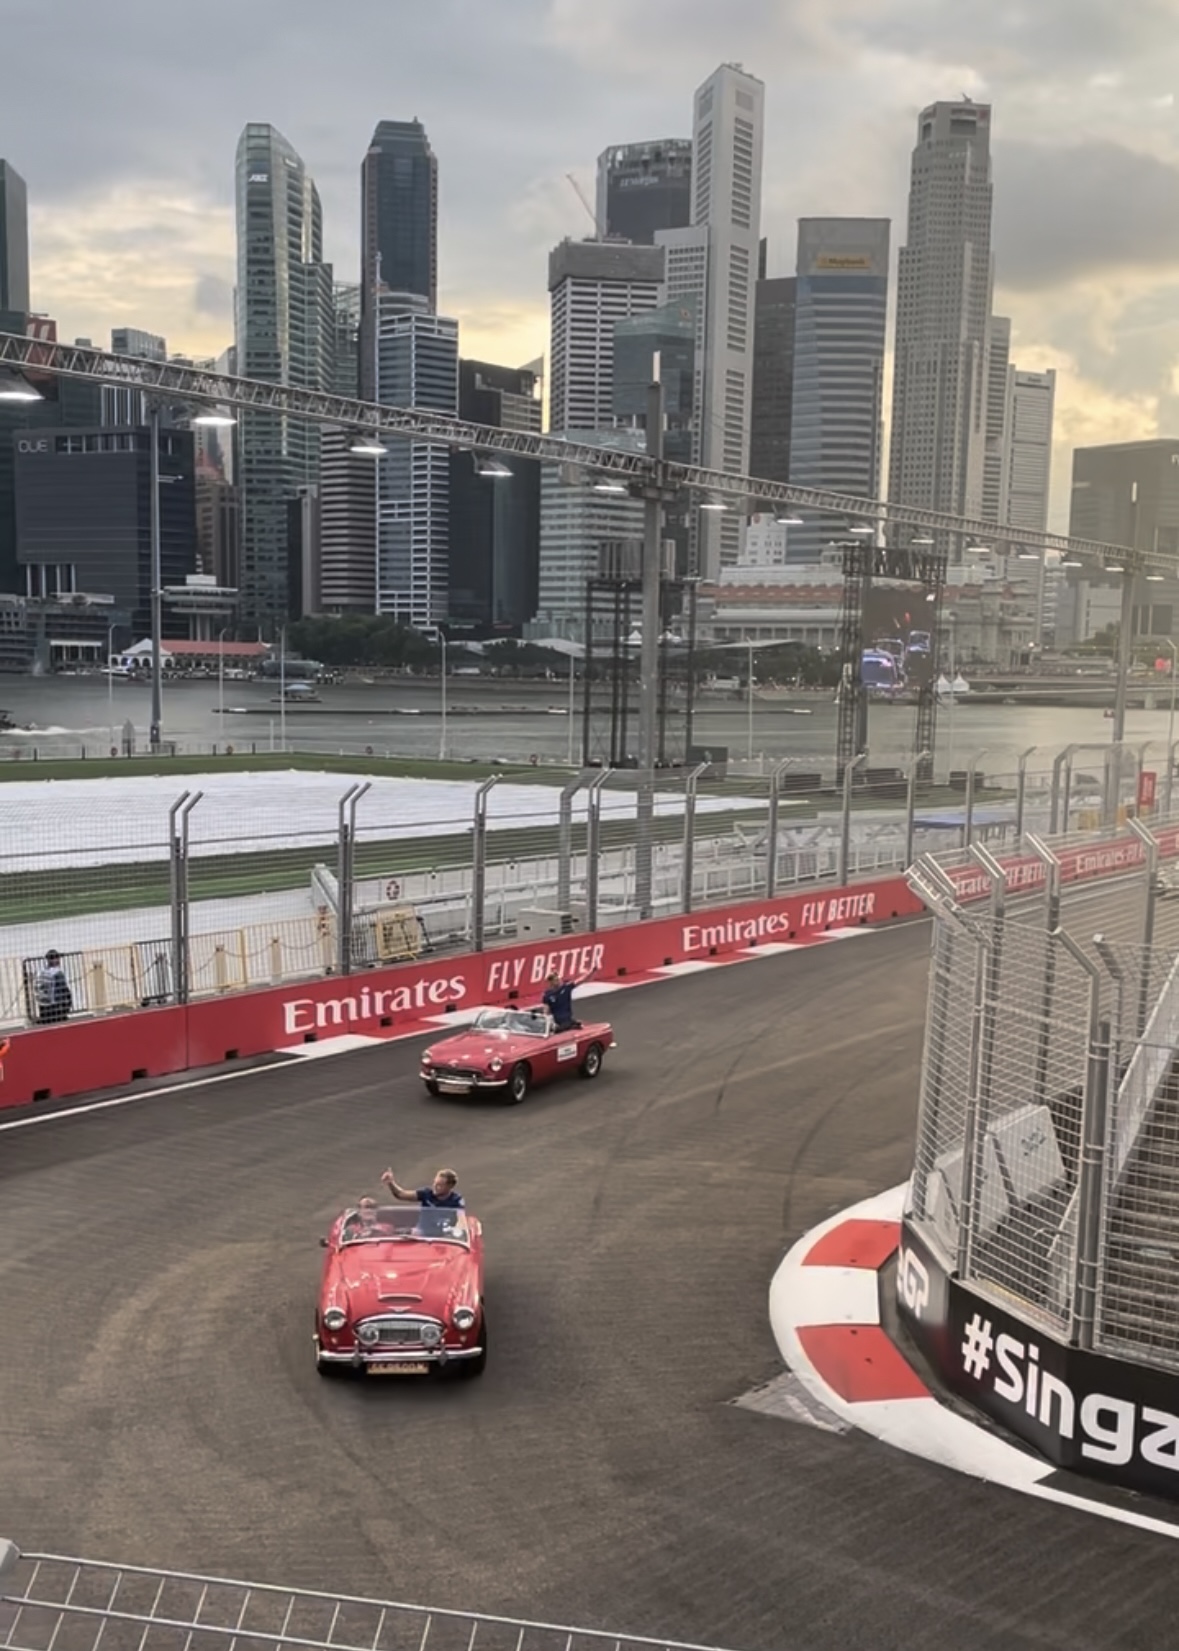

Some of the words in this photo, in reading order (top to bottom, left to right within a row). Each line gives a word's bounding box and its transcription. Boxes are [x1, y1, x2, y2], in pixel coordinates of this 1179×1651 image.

[682, 912, 790, 952] Emirates
[800, 899, 827, 927] FLY
[827, 892, 875, 924] BETTER
[283, 975, 466, 1034] Emirates
[488, 958, 526, 992] FLY
[531, 944, 604, 984] BETTER
